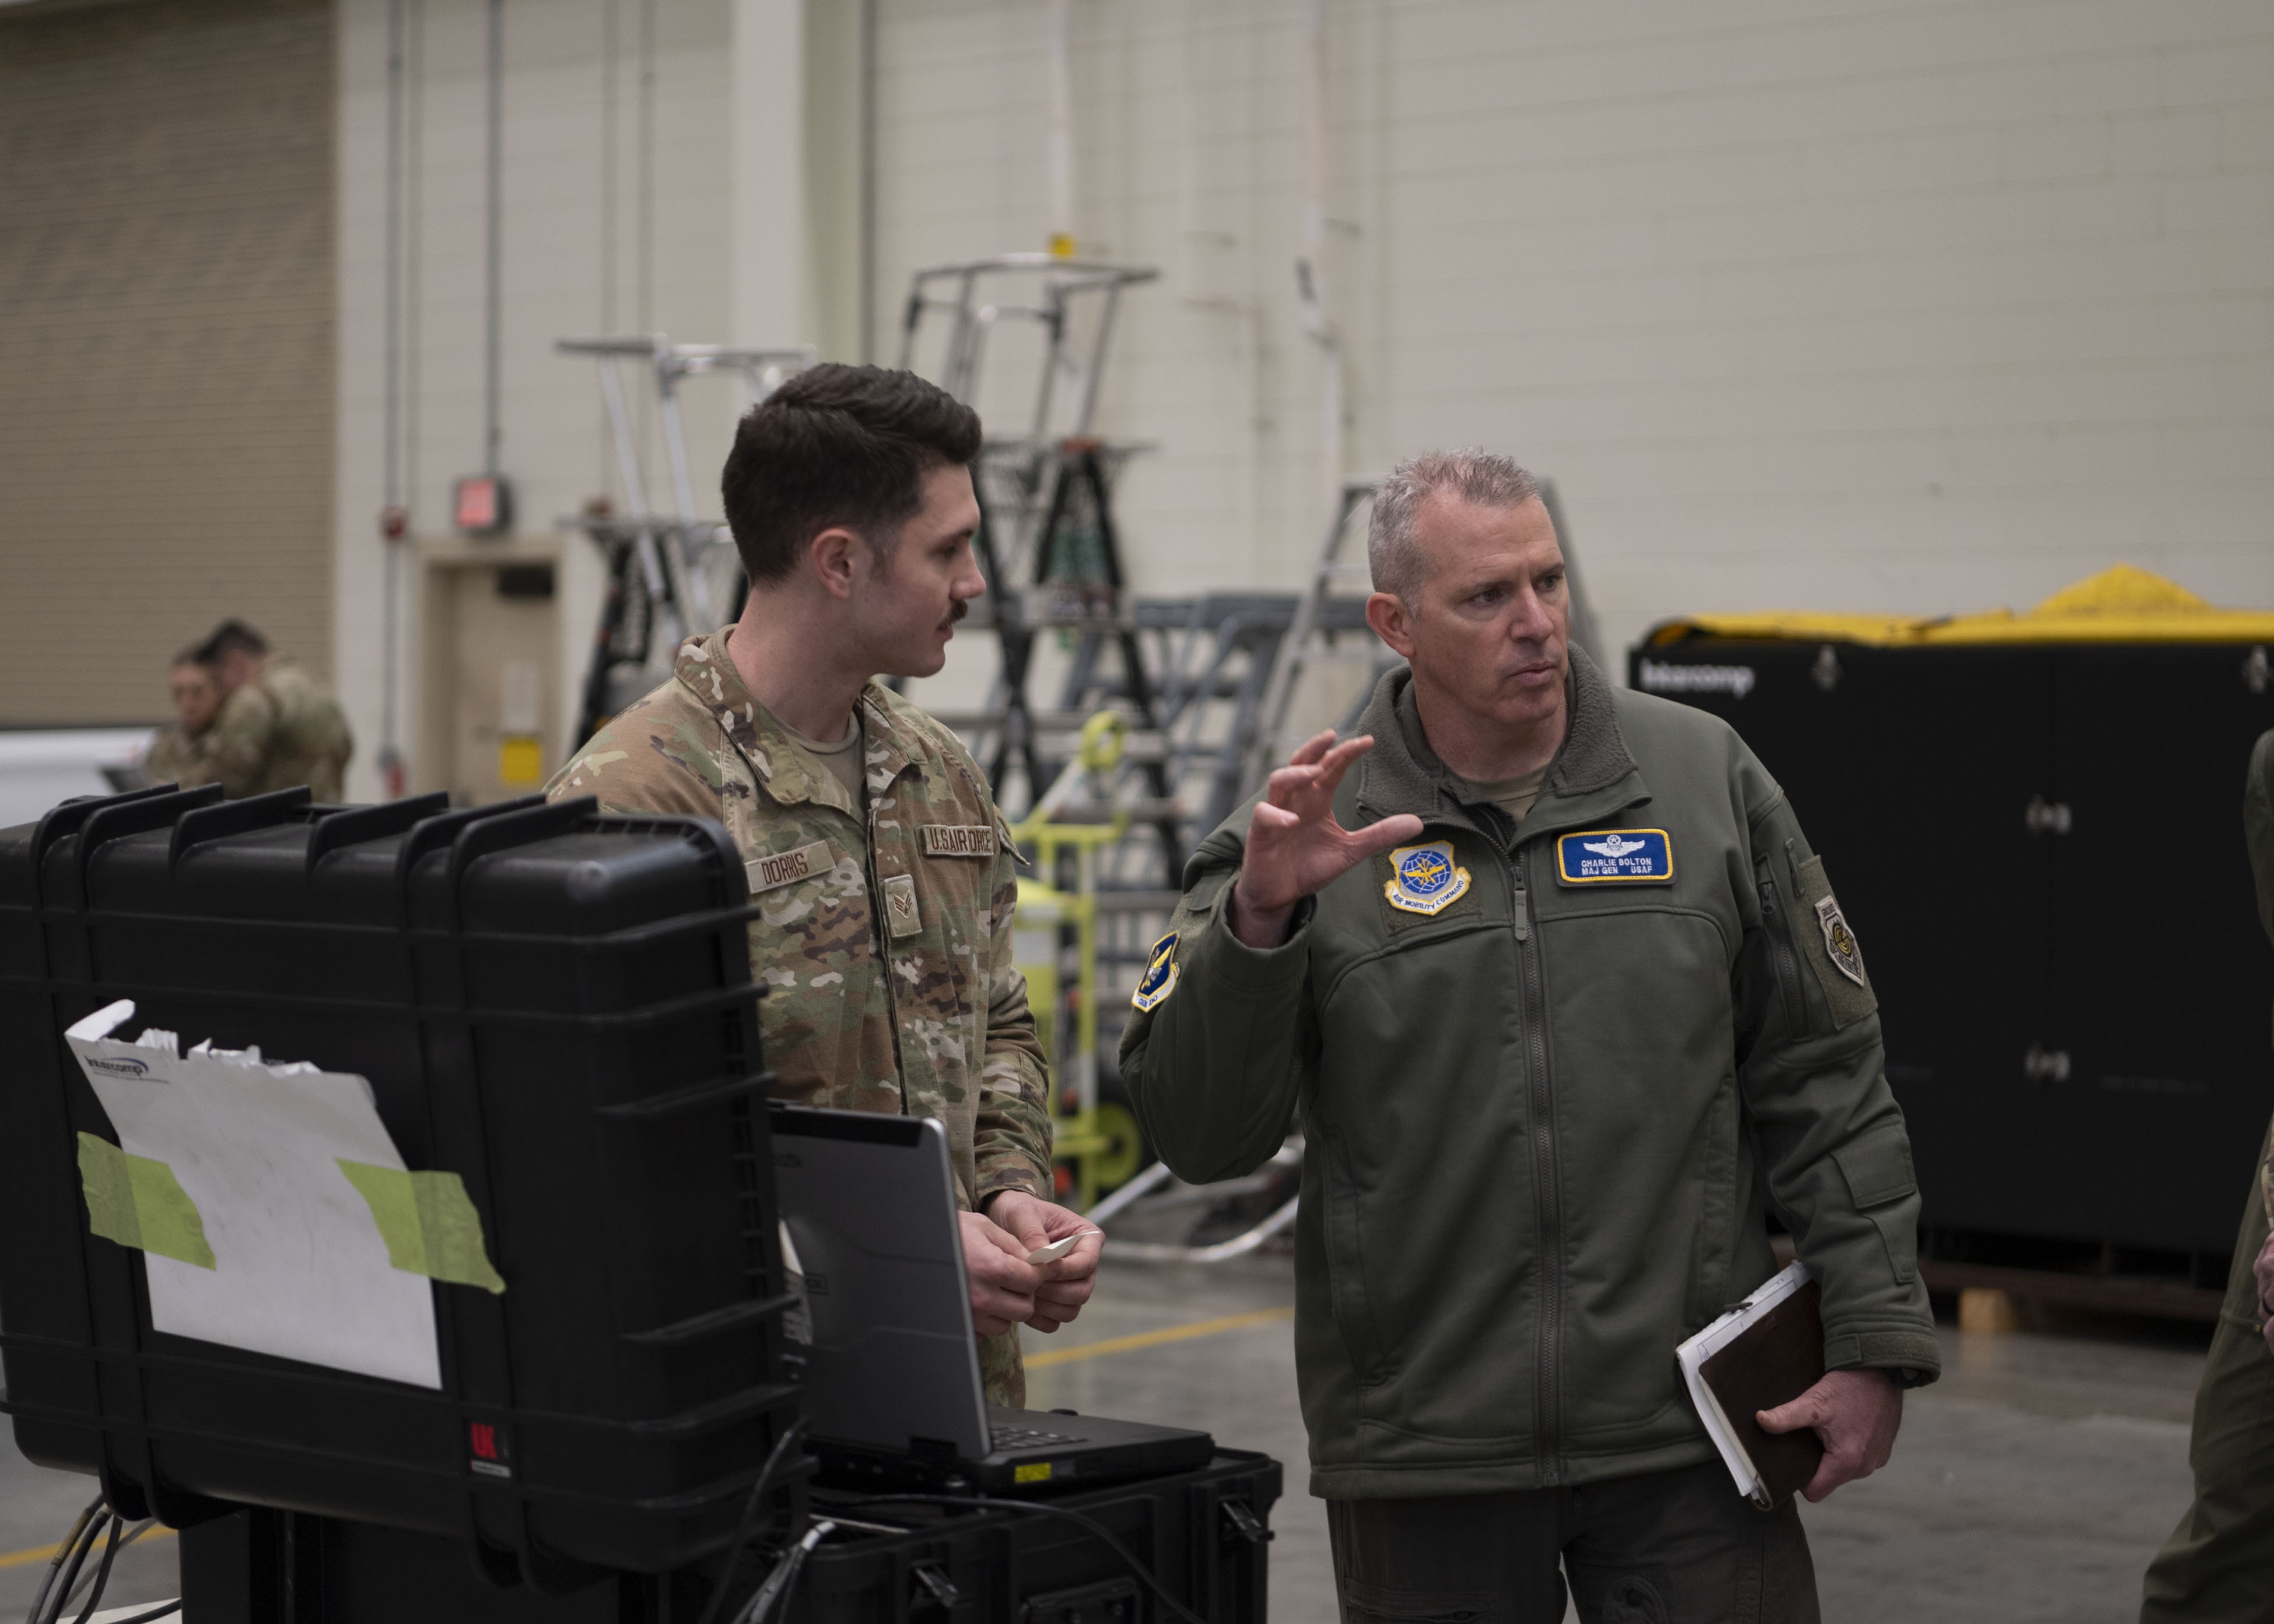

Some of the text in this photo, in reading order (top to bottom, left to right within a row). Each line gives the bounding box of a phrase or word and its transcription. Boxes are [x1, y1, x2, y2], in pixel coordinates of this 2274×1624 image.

[948, 829, 968, 851] AIR
[761, 853, 808, 885] DORRIS
[1581, 857, 1652, 868] CHARLIE BOLTON
[1581, 867, 1599, 876] MAJ
[1631, 866, 1652, 874] USAF
[1393, 880, 1464, 910] AIR MOBILITY COMMAND
